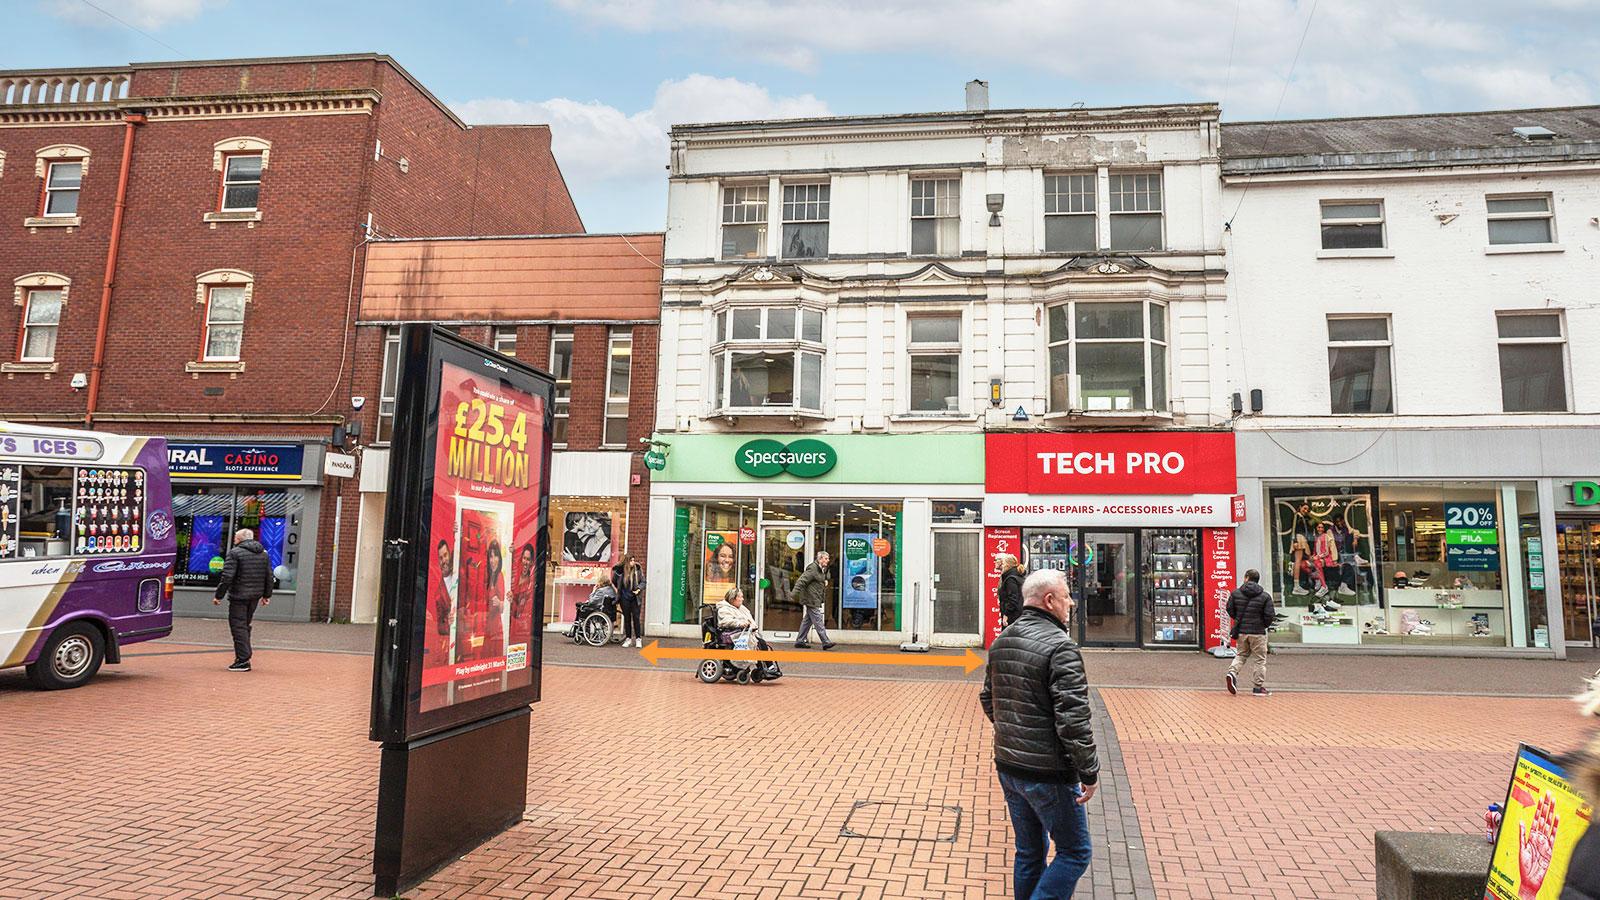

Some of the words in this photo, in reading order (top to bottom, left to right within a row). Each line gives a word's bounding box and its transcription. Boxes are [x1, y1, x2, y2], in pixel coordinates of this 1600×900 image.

[454, 399, 527, 451] £25.4
[33, 440, 77, 455] ICES
[167, 448, 213, 465] RAL
[224, 454, 279, 465] CASINO
[448, 436, 528, 486] MILLION
[744, 449, 827, 466] Specsavers
[1037, 452, 1115, 474] TECH
[1127, 452, 1185, 474] PRO
[1002, 505, 1045, 514] PHONES
[1052, 505, 1094, 514] REPAIRS
[1102, 505, 1174, 514] ACCESSORIES
[1447, 507, 1493, 526] 20%
[32, 564, 60, 575] when
